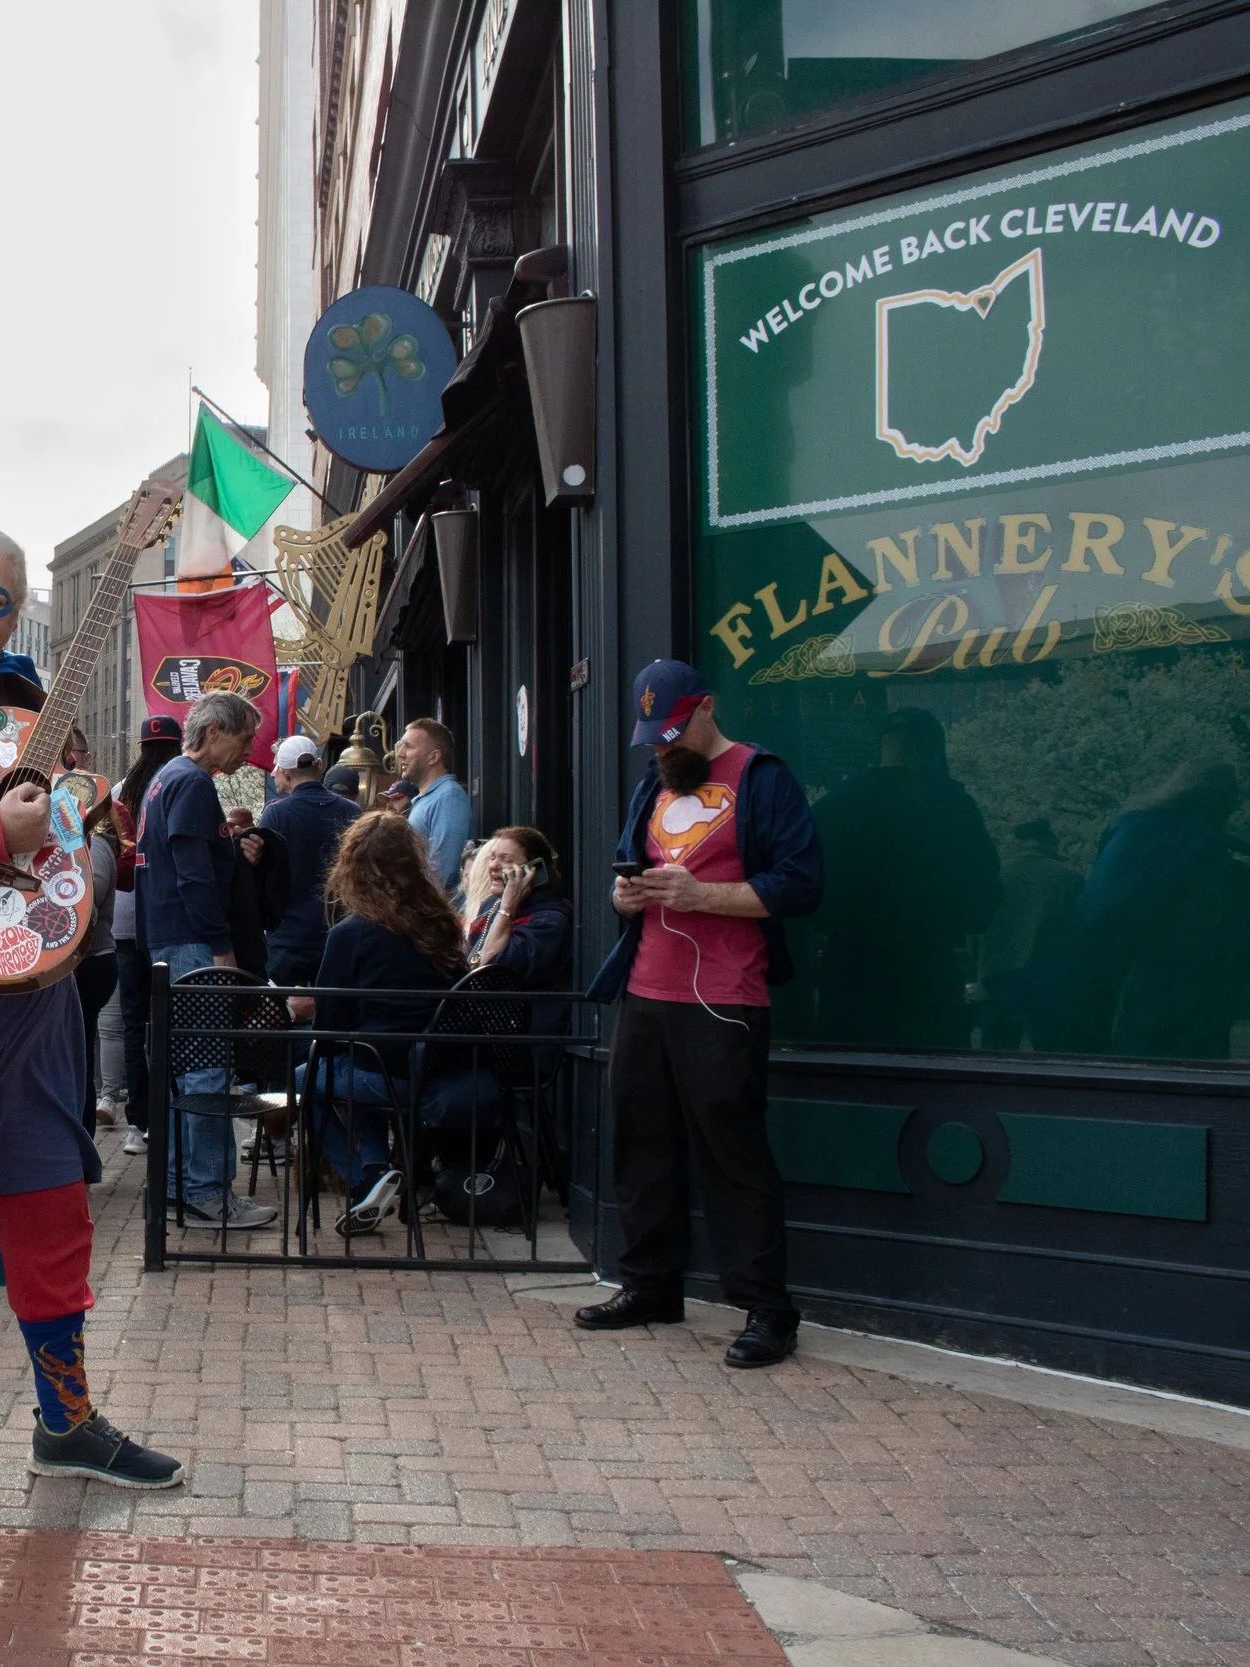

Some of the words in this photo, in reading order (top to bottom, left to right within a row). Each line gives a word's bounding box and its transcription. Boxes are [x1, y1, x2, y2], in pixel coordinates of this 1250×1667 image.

[739, 248, 893, 354] WELCOME
[901, 214, 992, 266] BACK
[999, 202, 1221, 249] CLEVELAND
[339, 427, 419, 440] IRELAND
[866, 583, 1068, 679] Pub
[662, 727, 682, 743] NBA
[59, 935, 71, 945] THE
